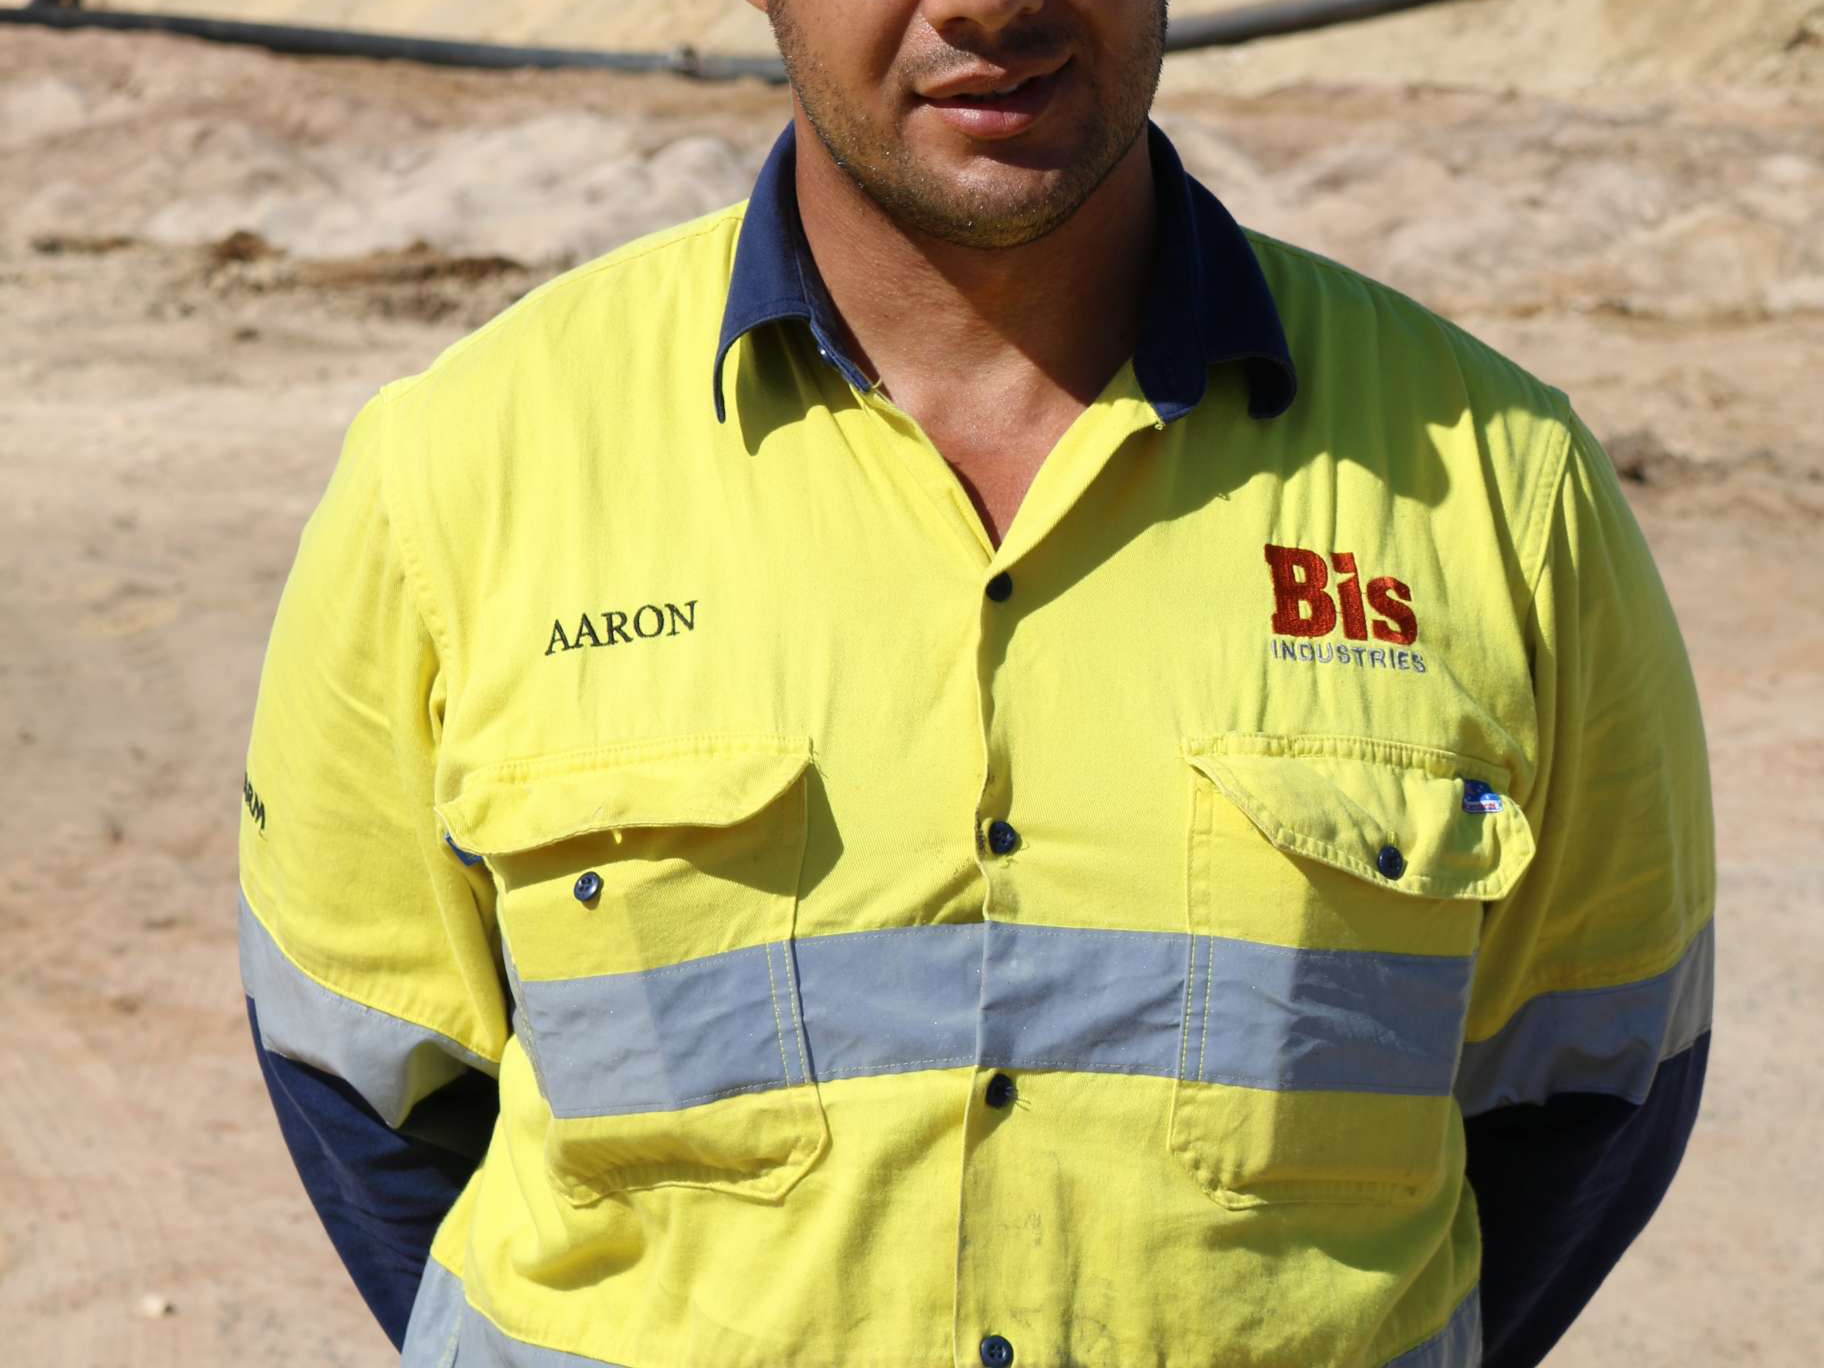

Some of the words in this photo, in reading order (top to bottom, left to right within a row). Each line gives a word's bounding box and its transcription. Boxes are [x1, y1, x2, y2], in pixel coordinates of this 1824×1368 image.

[1264, 543, 1418, 646] Bis
[545, 600, 698, 656] AARON
[1271, 639, 1426, 673] INDUSTRIES
